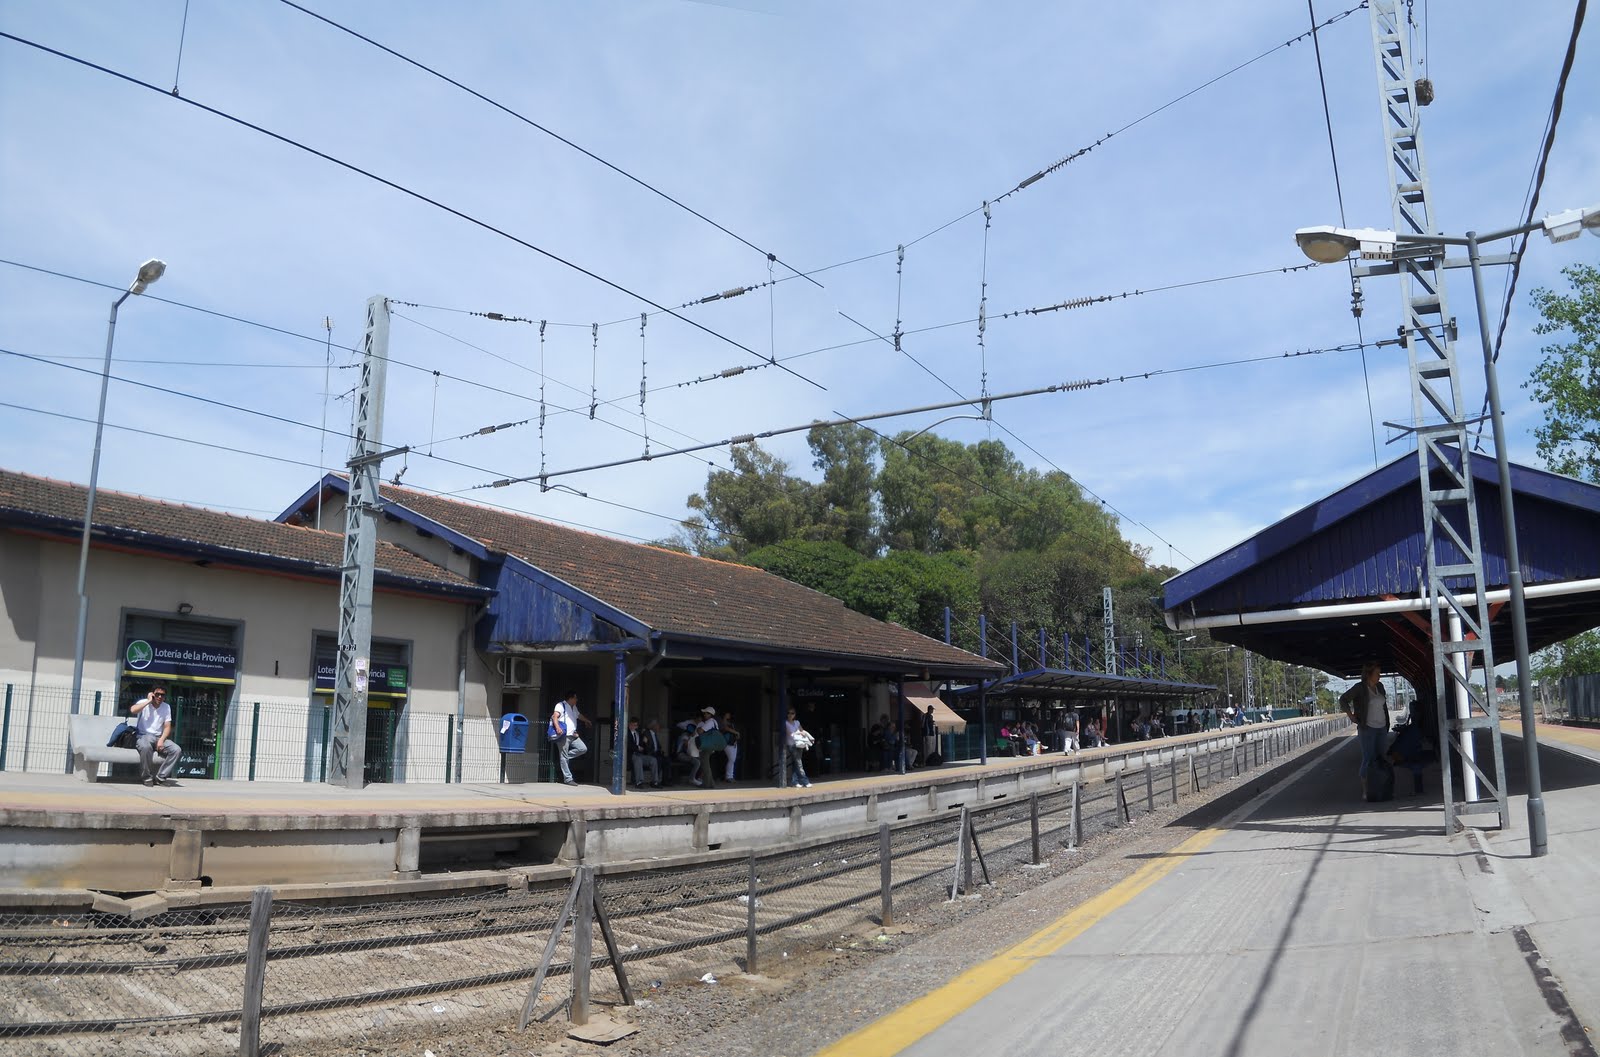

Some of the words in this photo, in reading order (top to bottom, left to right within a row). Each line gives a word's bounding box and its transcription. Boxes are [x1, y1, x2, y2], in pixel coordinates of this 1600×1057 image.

[154, 648, 181, 659] Lotería
[182, 650, 193, 660] de
[193, 651, 200, 661] la
[202, 652, 235, 664] Provincia
